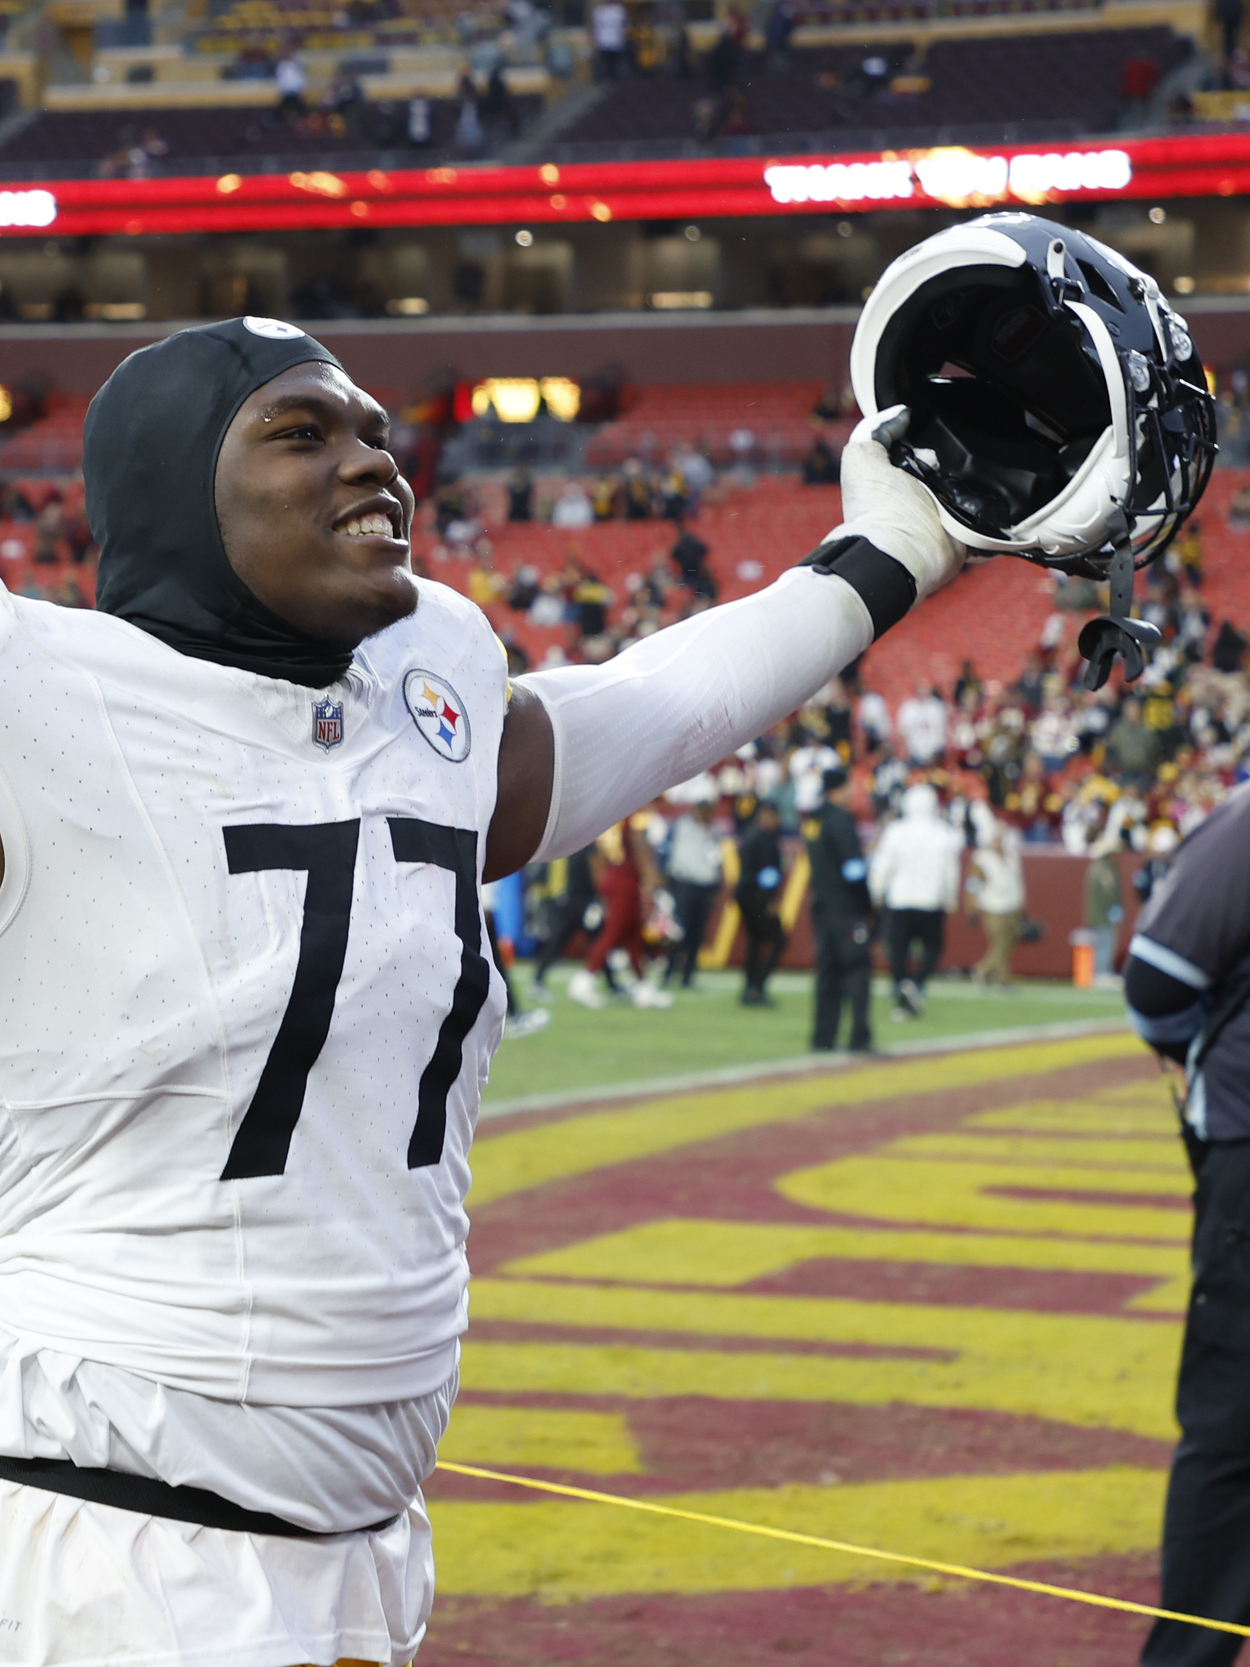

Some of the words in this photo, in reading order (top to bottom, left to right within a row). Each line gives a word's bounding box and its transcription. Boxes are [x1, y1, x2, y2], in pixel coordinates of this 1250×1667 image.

[414, 706, 438, 719] Steelers
[318, 721, 340, 743] NFL
[219, 816, 490, 1181] 77
